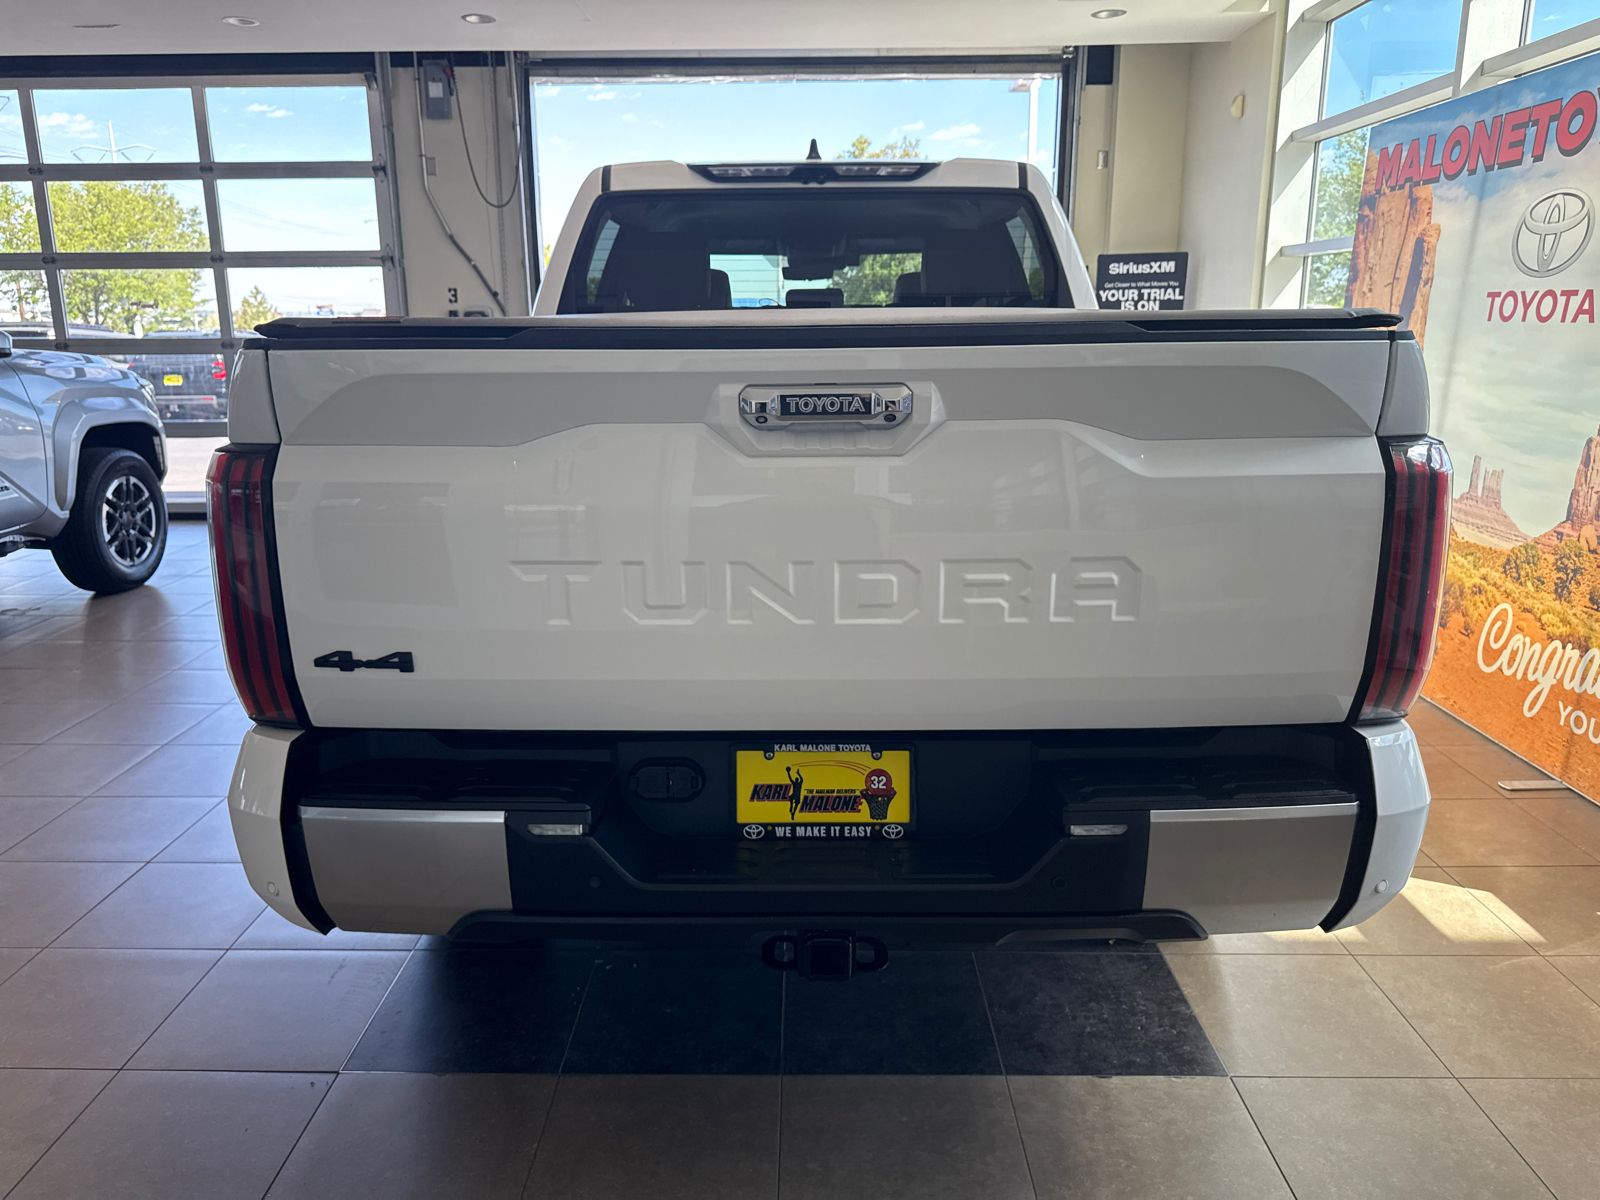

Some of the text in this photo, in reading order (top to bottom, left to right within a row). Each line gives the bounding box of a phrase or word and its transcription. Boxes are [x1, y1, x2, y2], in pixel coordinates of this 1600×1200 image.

[1374, 87, 1600, 194] MALONETO
[1108, 260, 1176, 275] SiriusXM
[448, 287, 458, 304] 3
[1099, 287, 1184, 302] YOUR TRIAL
[1120, 300, 1160, 311] IS ON
[1486, 288, 1595, 324] TOYOTA
[786, 396, 865, 413] TOYOTA
[508, 555, 1144, 625] TUNDRA
[1477, 602, 1600, 718] Congra
[774, 744, 872, 752] KARL MALONE TOYOTA
[870, 776, 887, 789] 32
[749, 784, 792, 801] KARL
[798, 795, 863, 813] MALONE
[775, 826, 872, 838] WE MAKE IT EASY
